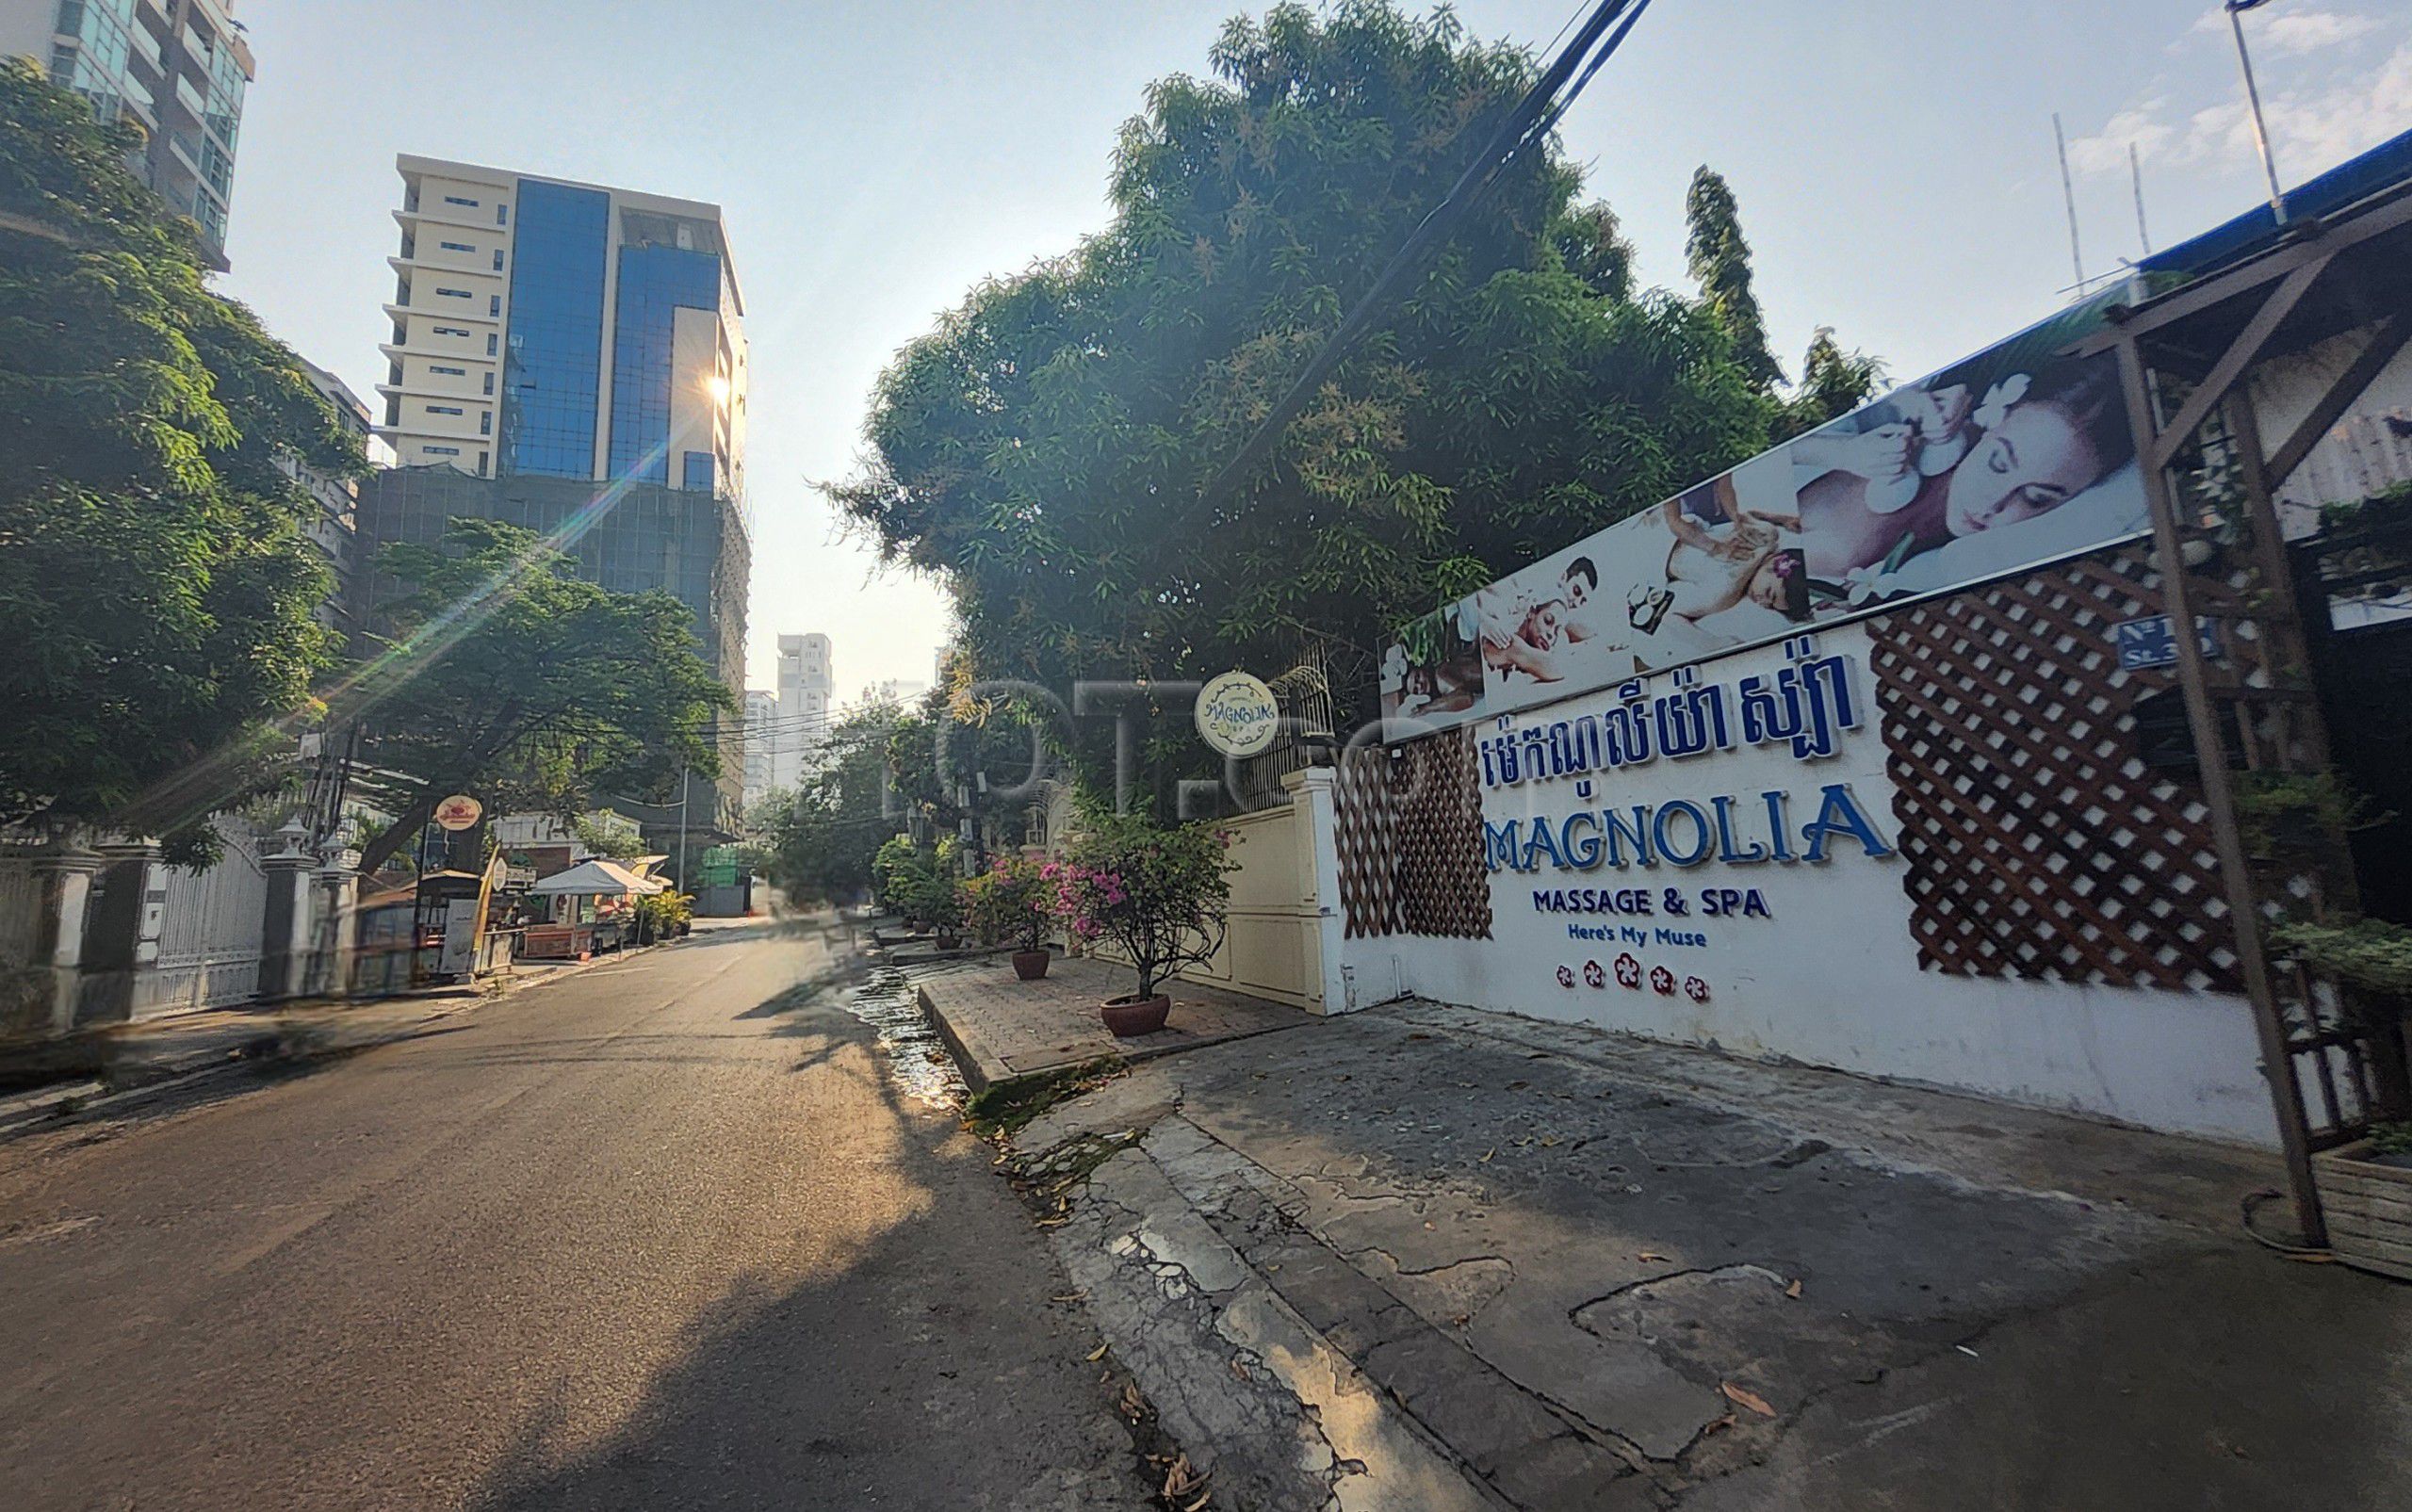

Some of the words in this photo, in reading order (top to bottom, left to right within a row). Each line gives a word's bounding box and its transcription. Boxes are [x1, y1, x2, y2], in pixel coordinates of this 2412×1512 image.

[1203, 702, 1275, 724] MAGNOLIA
[1483, 784, 1896, 871] MAGNOLIA
[1533, 887, 1654, 915] MASSAGE
[1664, 886, 1689, 916] &
[1702, 887, 1770, 918] SPA
[1568, 922, 1616, 942] Here's
[1621, 926, 1648, 948] My
[1654, 926, 1707, 948] Muse
